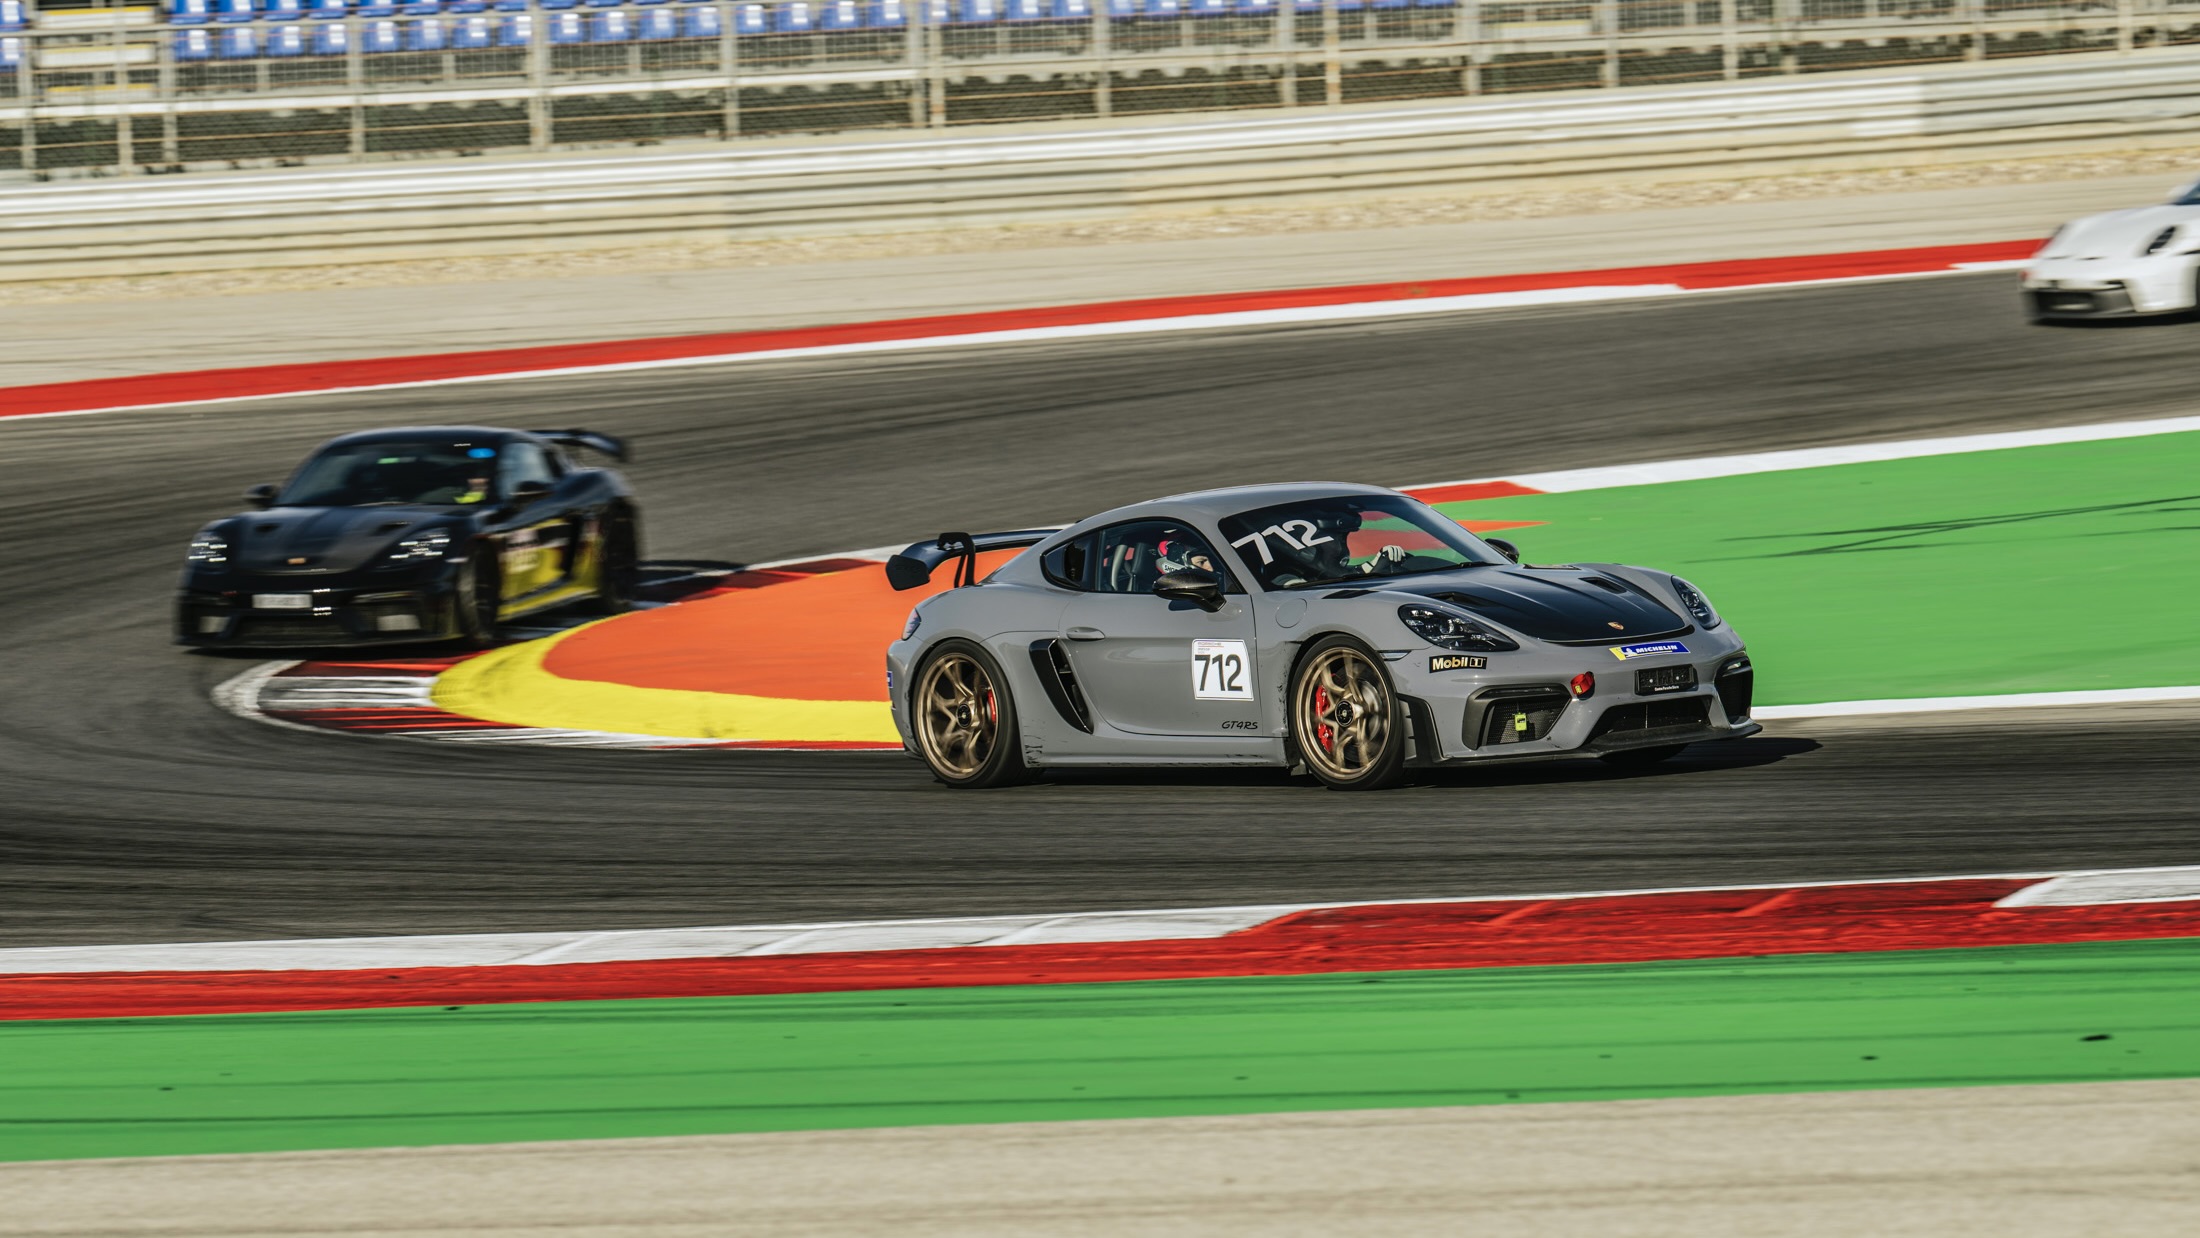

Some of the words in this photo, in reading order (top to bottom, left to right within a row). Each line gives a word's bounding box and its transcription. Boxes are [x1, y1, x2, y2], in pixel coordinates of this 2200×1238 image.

[1231, 519, 1334, 565] 712
[1635, 645, 1678, 654] MICHELIN
[1432, 656, 1469, 670] Mobil
[1195, 653, 1243, 691] 712
[1221, 720, 1258, 730] GT4RS
